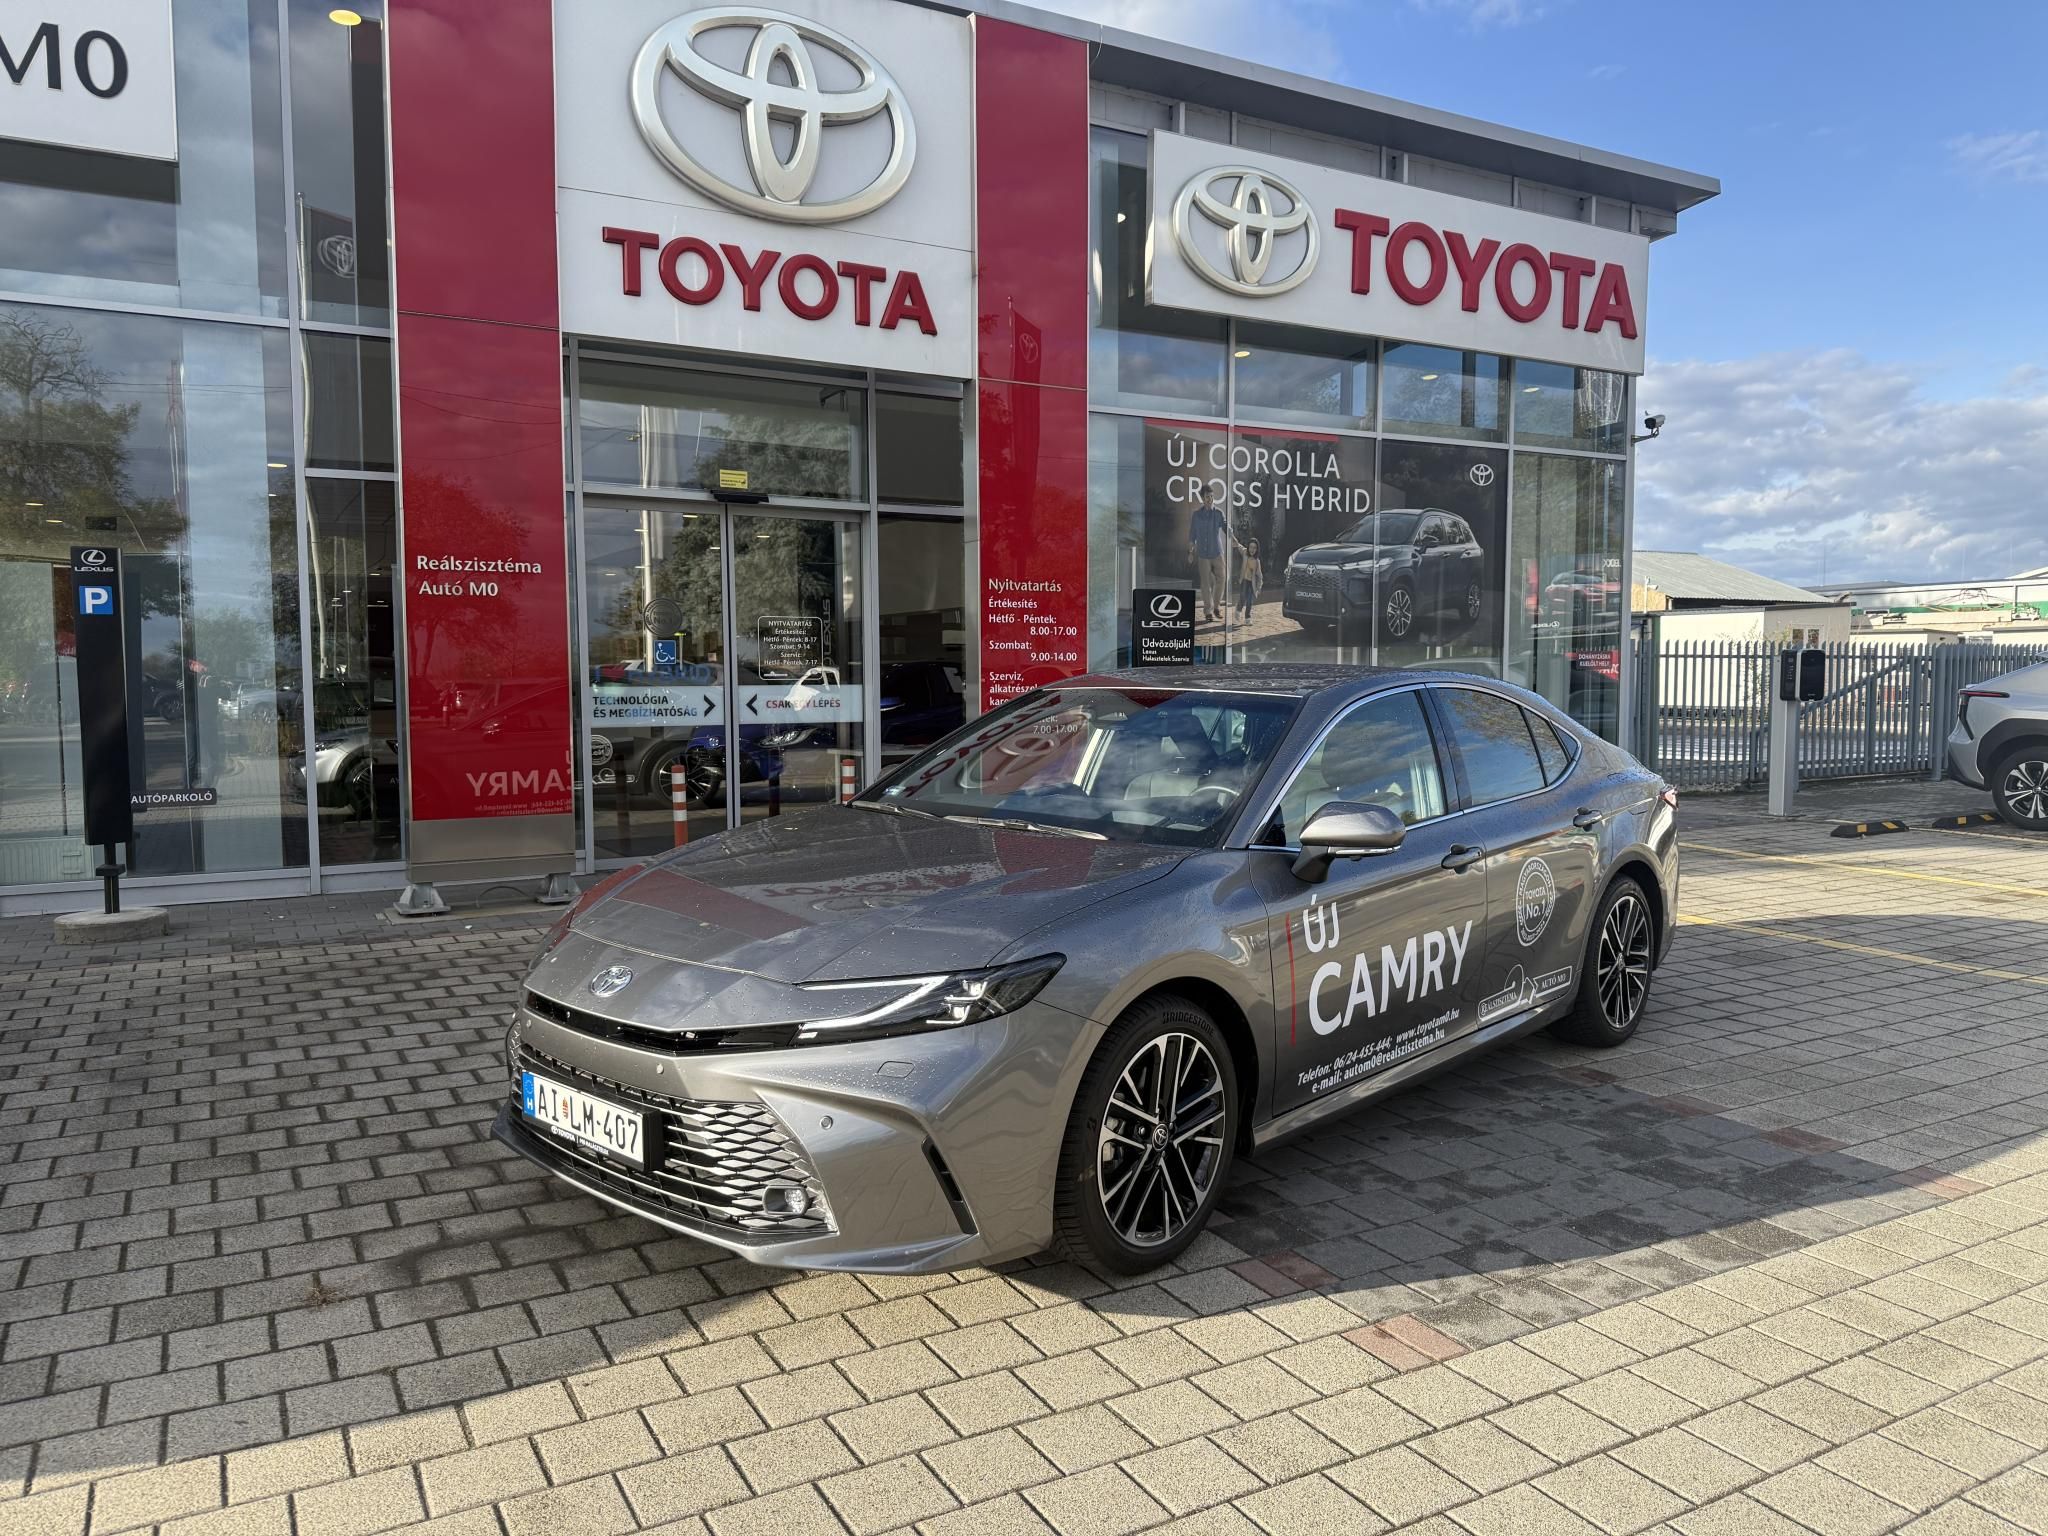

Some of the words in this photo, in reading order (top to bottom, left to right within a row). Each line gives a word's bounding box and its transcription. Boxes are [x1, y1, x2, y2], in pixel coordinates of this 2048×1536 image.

[602, 226, 938, 336] TOYOTA
[1334, 207, 1638, 340] TOYOTA
[1167, 433, 1197, 468] ÚJ
[1209, 443, 1341, 479] COROLLA
[1166, 475, 1263, 508] CROSS
[1274, 483, 1370, 514] HYBRID
[417, 555, 542, 573] Reálszisztéma
[419, 580, 463, 596] Autó
[469, 582, 499, 597] M0
[988, 578, 1062, 594] Nyitvatartás
[84, 587, 109, 614] P
[988, 596, 1038, 608] Értékesítés
[988, 613, 1015, 623] Hétfő
[1023, 614, 1057, 624] Péntek:
[1141, 620, 1190, 629] LEXUS
[1030, 626, 1077, 636] 8.00-17.00
[989, 640, 1032, 650] Szombat:
[1142, 637, 1191, 650] Üdvözöljük!
[1030, 652, 1077, 661] 9.00-14.00
[989, 671, 1024, 681] Szerviz,
[592, 694, 669, 706] TECHNOLÓGIA
[766, 700, 791, 709] CSAK
[813, 698, 841, 708] LÉPÉS
[593, 706, 606, 718] ÉS
[609, 705, 698, 718] MEGBÍZHATÓSÁG
[130, 790, 213, 804] AUTÓPARKOLÓ
[1526, 886, 1546, 900] TOYOTA
[1526, 900, 1546, 921] No.1
[1302, 894, 1340, 953] ÚJ
[1308, 919, 1473, 1036] CAMRY
[1297, 1063, 1332, 1086] Telefon:
[1395, 1008, 1460, 1044] www.toyotam0.hu
[1312, 1071, 1342, 1093] e-mail:
[526, 1097, 534, 1110] H
[538, 1084, 559, 1123] AI
[569, 1095, 638, 1154] LM-407
